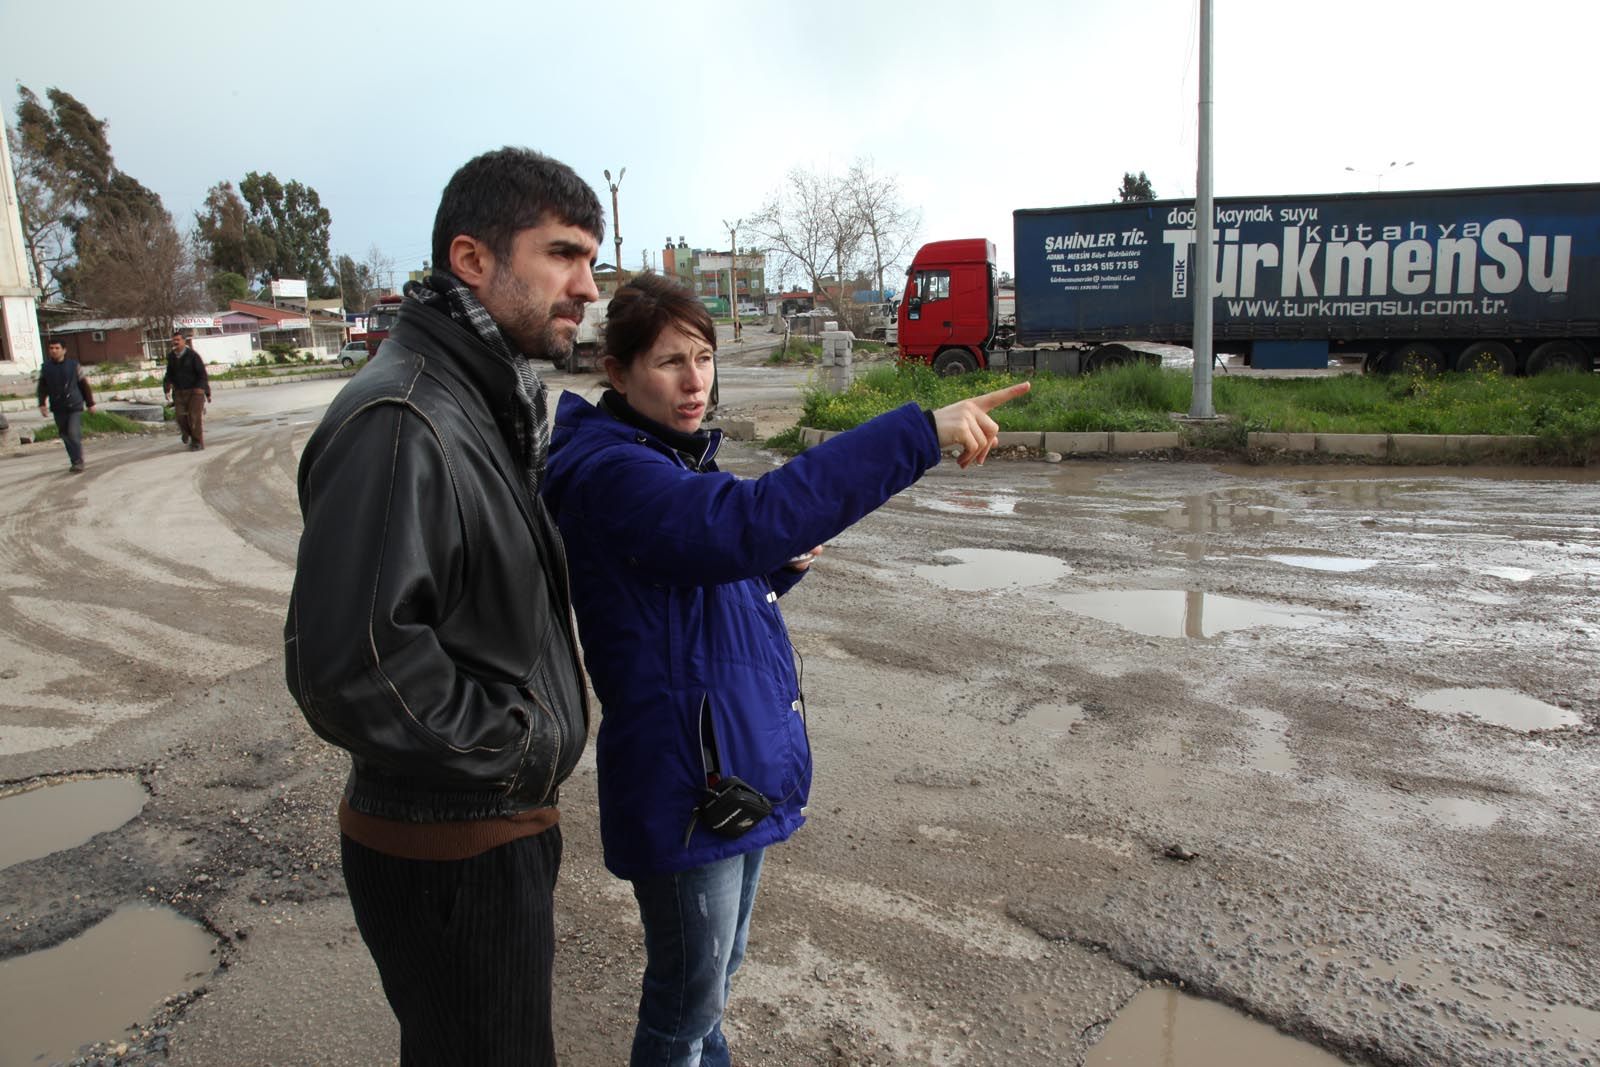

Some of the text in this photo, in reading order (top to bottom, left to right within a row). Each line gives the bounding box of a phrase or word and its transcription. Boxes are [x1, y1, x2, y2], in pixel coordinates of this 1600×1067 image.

[1216, 205, 1273, 228] kaynak
[1280, 208, 1318, 226] suyu
[1045, 228, 1148, 253] ŞAHİNLER TİC.
[1306, 221, 1480, 242] Kütahya
[1051, 264, 1072, 273] TEL.
[1163, 218, 1572, 298] TürkmenSu
[1174, 259, 1186, 296] incik
